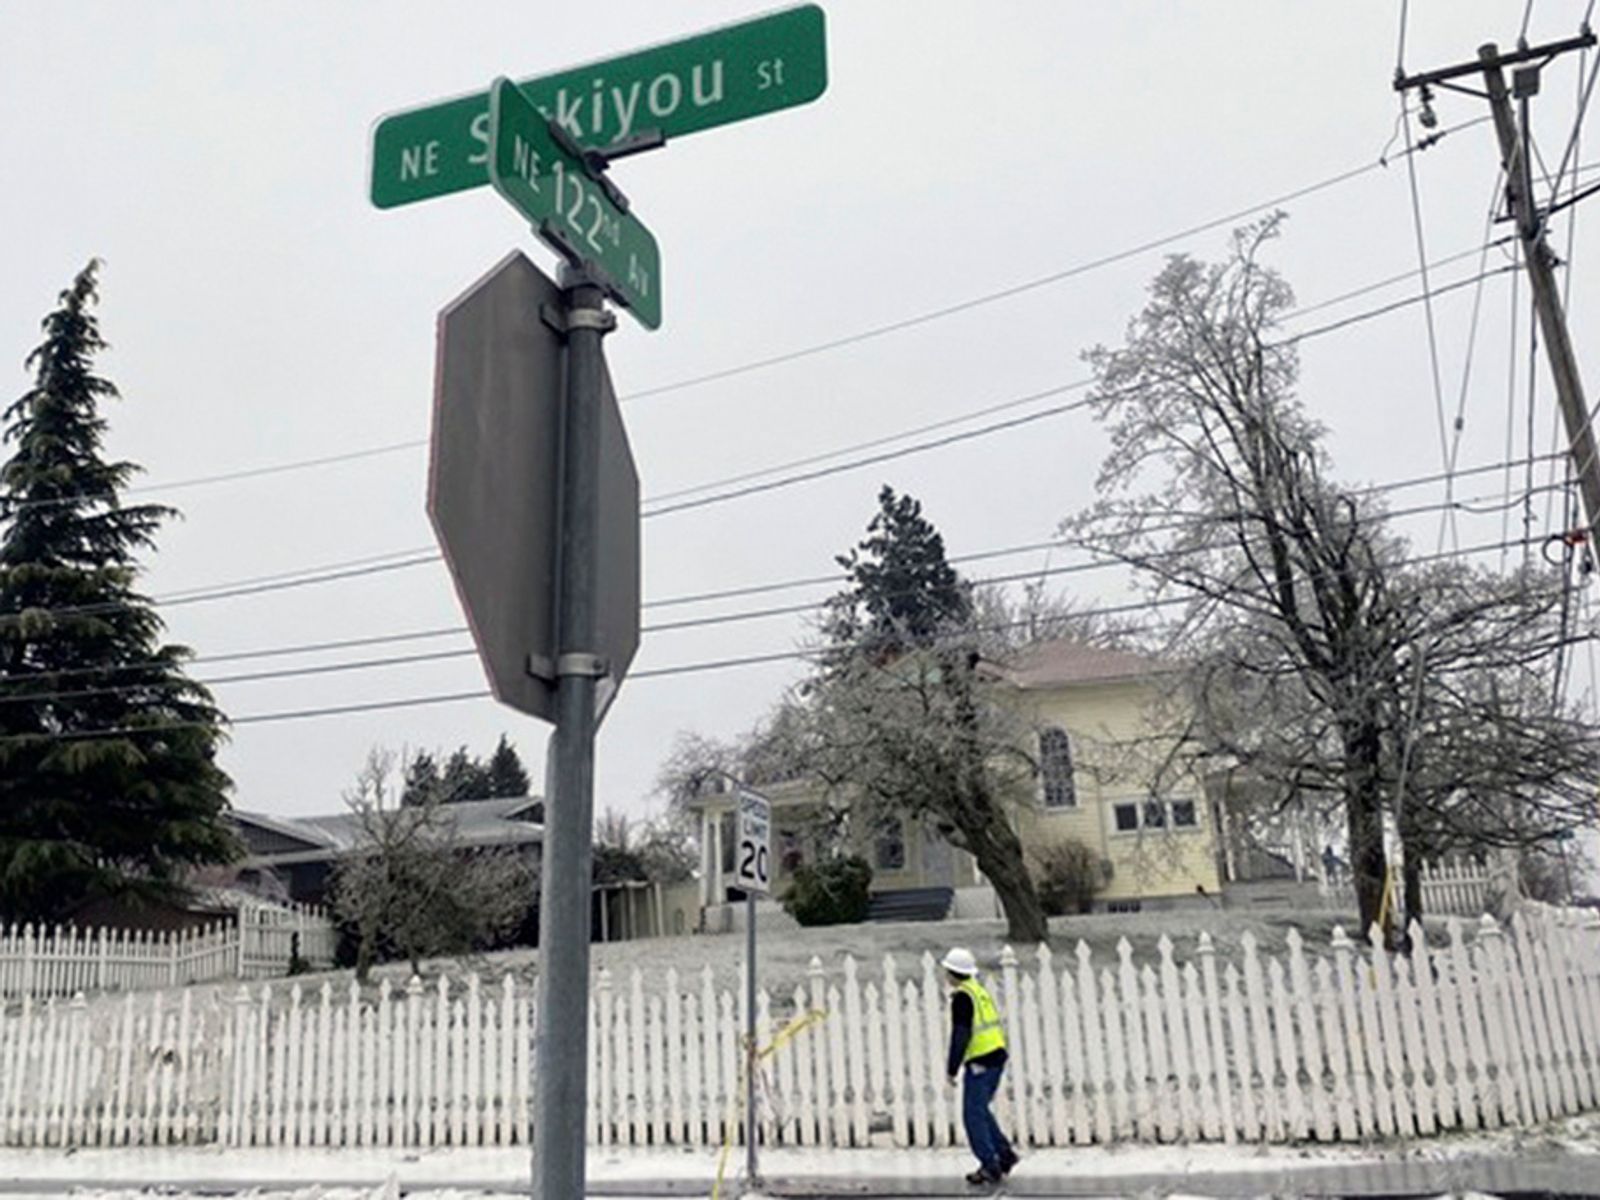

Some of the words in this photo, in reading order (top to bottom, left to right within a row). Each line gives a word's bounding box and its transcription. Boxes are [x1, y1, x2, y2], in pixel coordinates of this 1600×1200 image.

[400, 140, 440, 181] NE
[468, 59, 725, 165] Skiyou
[756, 58, 785, 90] St
[513, 135, 542, 191] NE
[628, 254, 649, 297] Av
